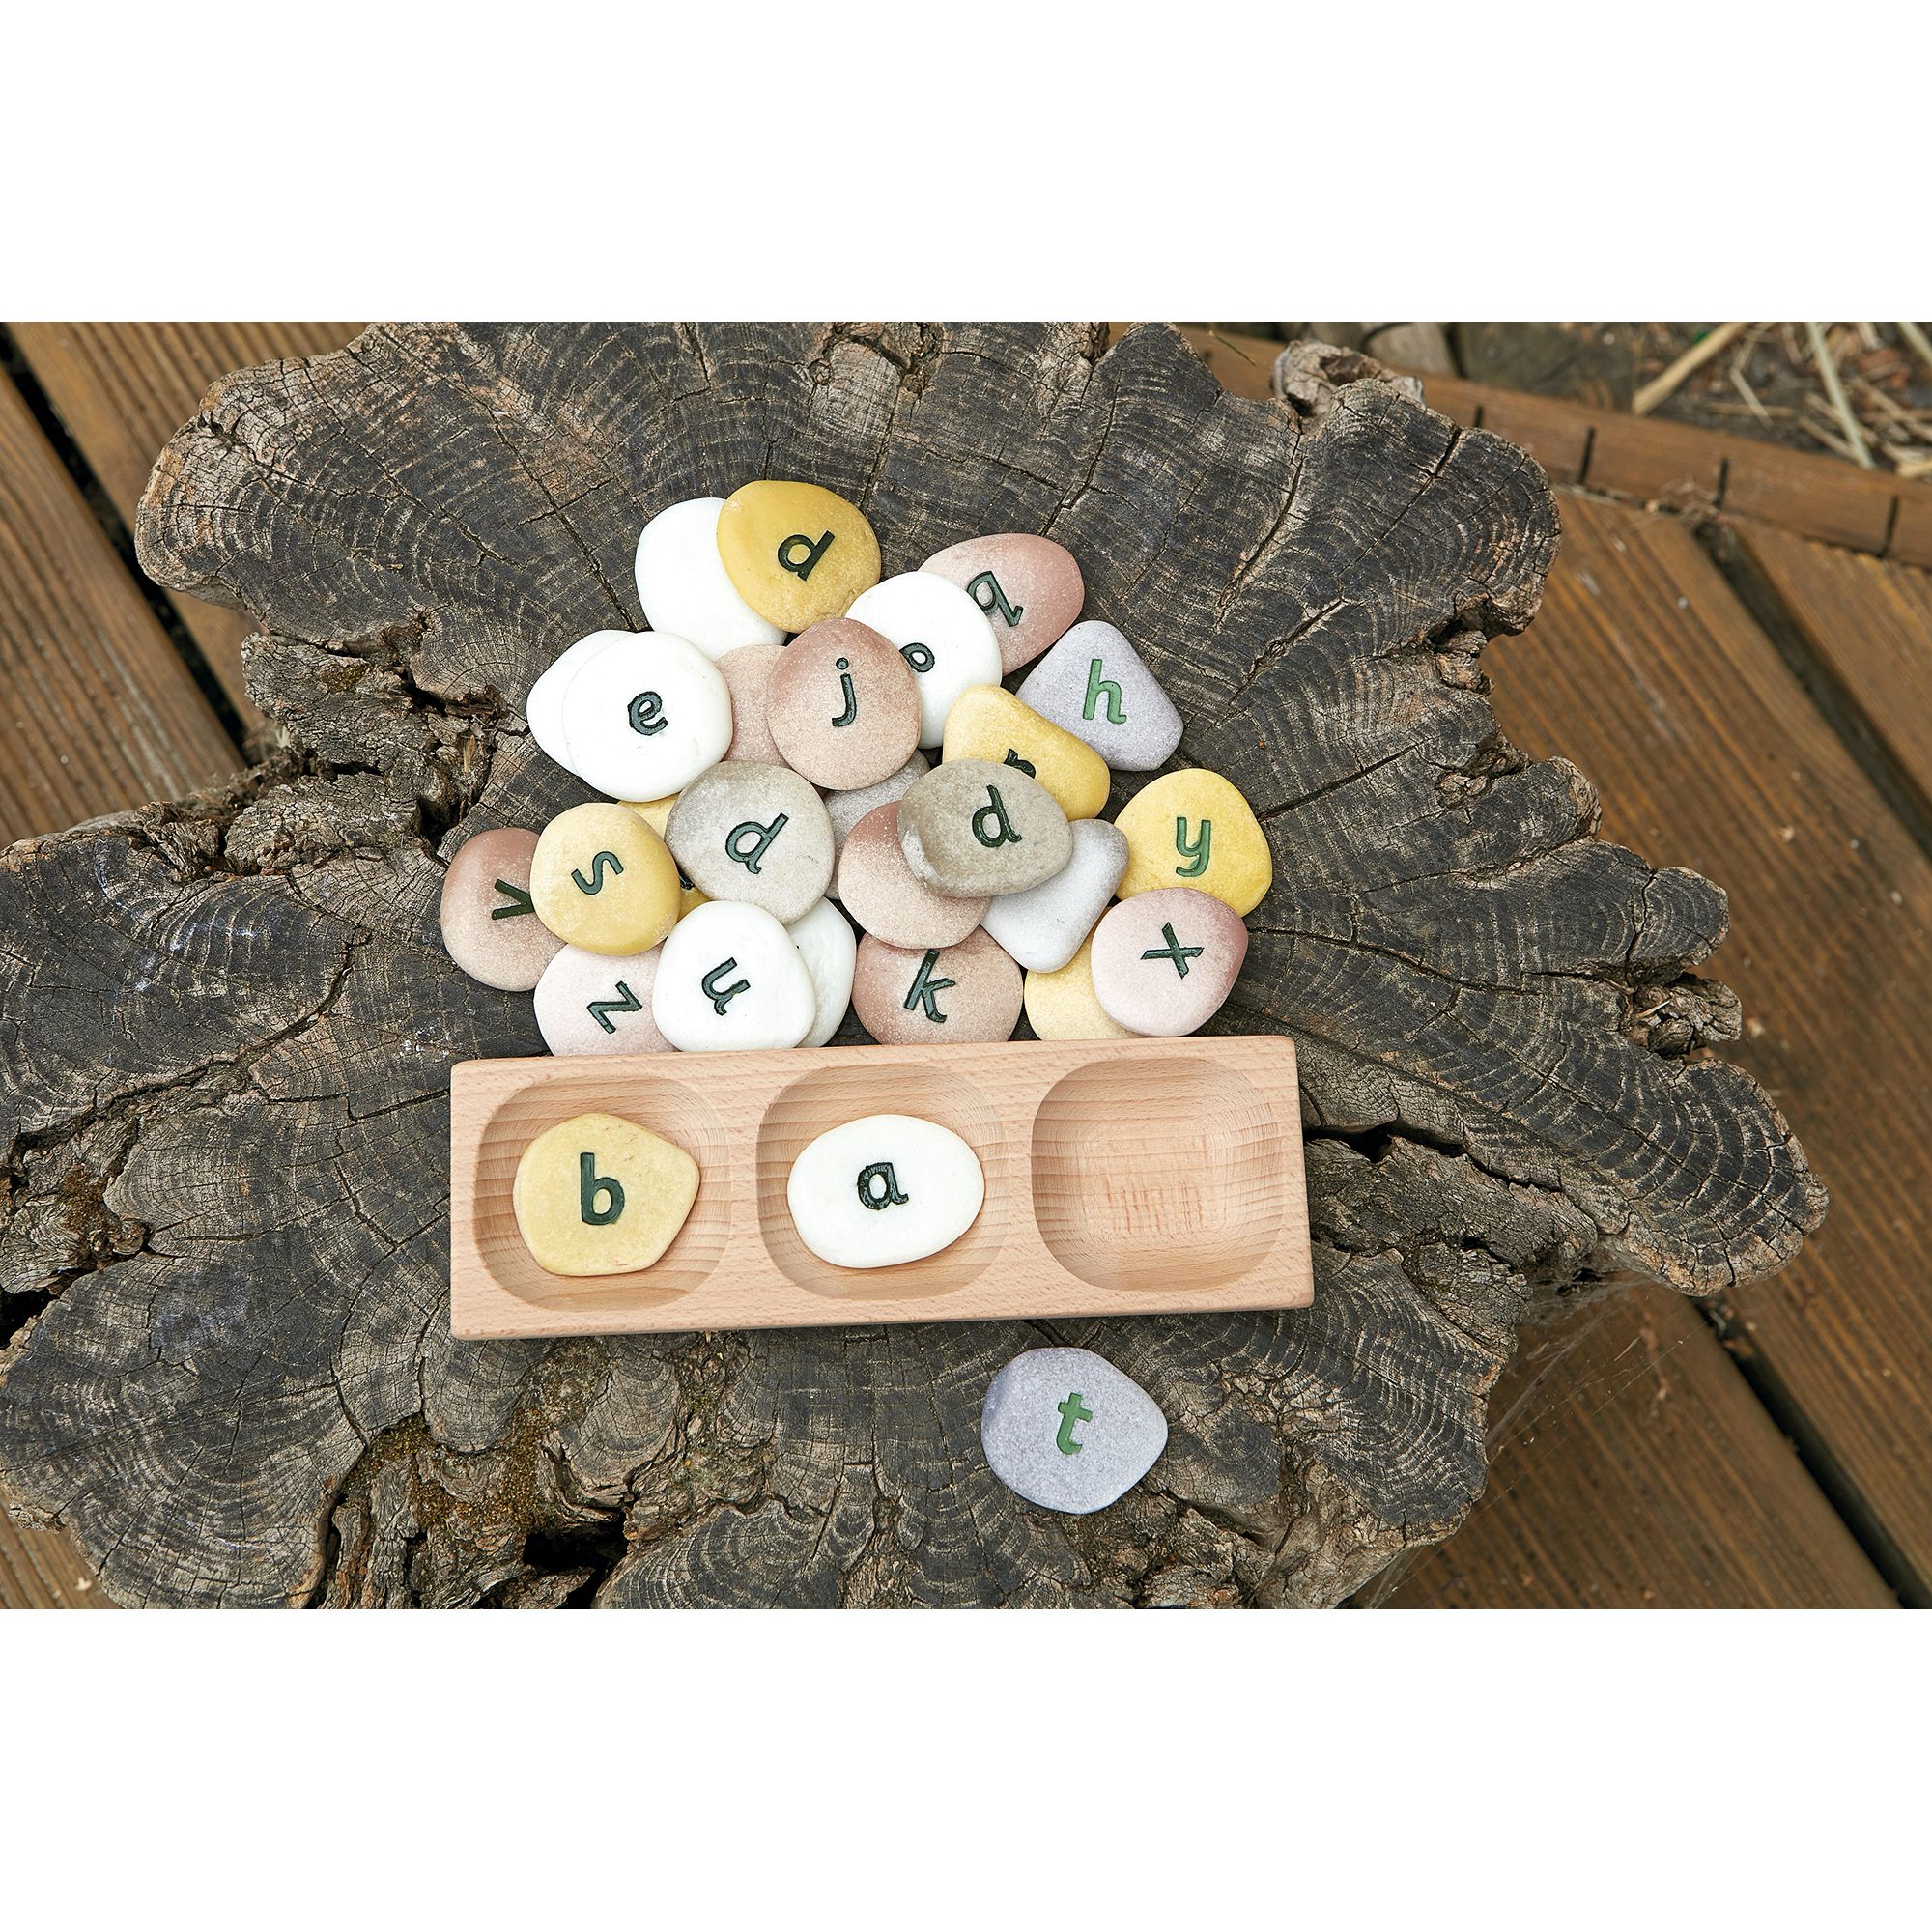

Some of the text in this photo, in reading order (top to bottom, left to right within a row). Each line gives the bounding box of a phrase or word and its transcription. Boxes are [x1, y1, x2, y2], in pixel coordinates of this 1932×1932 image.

[966, 571, 1023, 627] q
[627, 691, 668, 736] e
[832, 657, 857, 728] j
[1082, 659, 1127, 724] h
[725, 813, 789, 875] d
[972, 784, 1022, 848] d
[1176, 817, 1211, 877] y
[571, 851, 624, 895] s
[1141, 922, 1204, 979] x
[587, 981, 642, 1034] z
[903, 948, 956, 1023] k
[581, 1152, 909, 1225] b a
[1056, 1392, 1093, 1455] t
